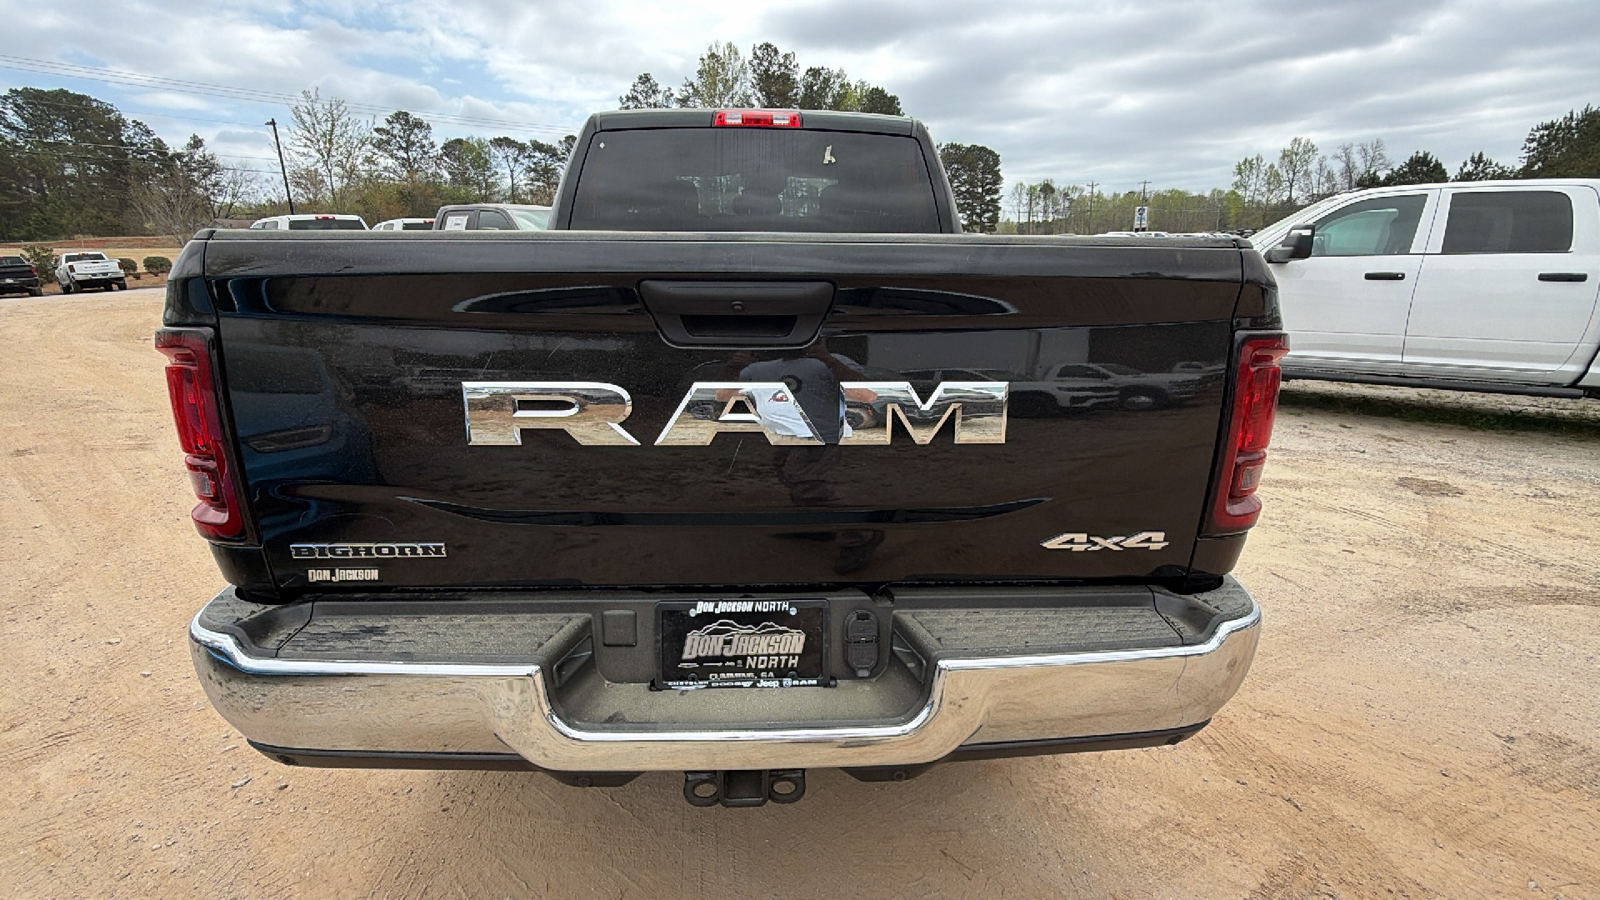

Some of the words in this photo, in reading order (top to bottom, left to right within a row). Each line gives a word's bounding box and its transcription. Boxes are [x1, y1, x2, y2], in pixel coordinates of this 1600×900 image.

[461, 381, 1010, 446] RAM
[290, 543, 447, 559] BIGHORN
[308, 569, 331, 582] DON
[332, 568, 379, 582] JACKSON
[696, 601, 715, 614] DON
[715, 601, 753, 614] JACKSON
[755, 601, 789, 611] NORTH
[723, 633, 806, 656] JACKSON
[745, 656, 799, 669] NORTH
[757, 679, 780, 688] Jeep
